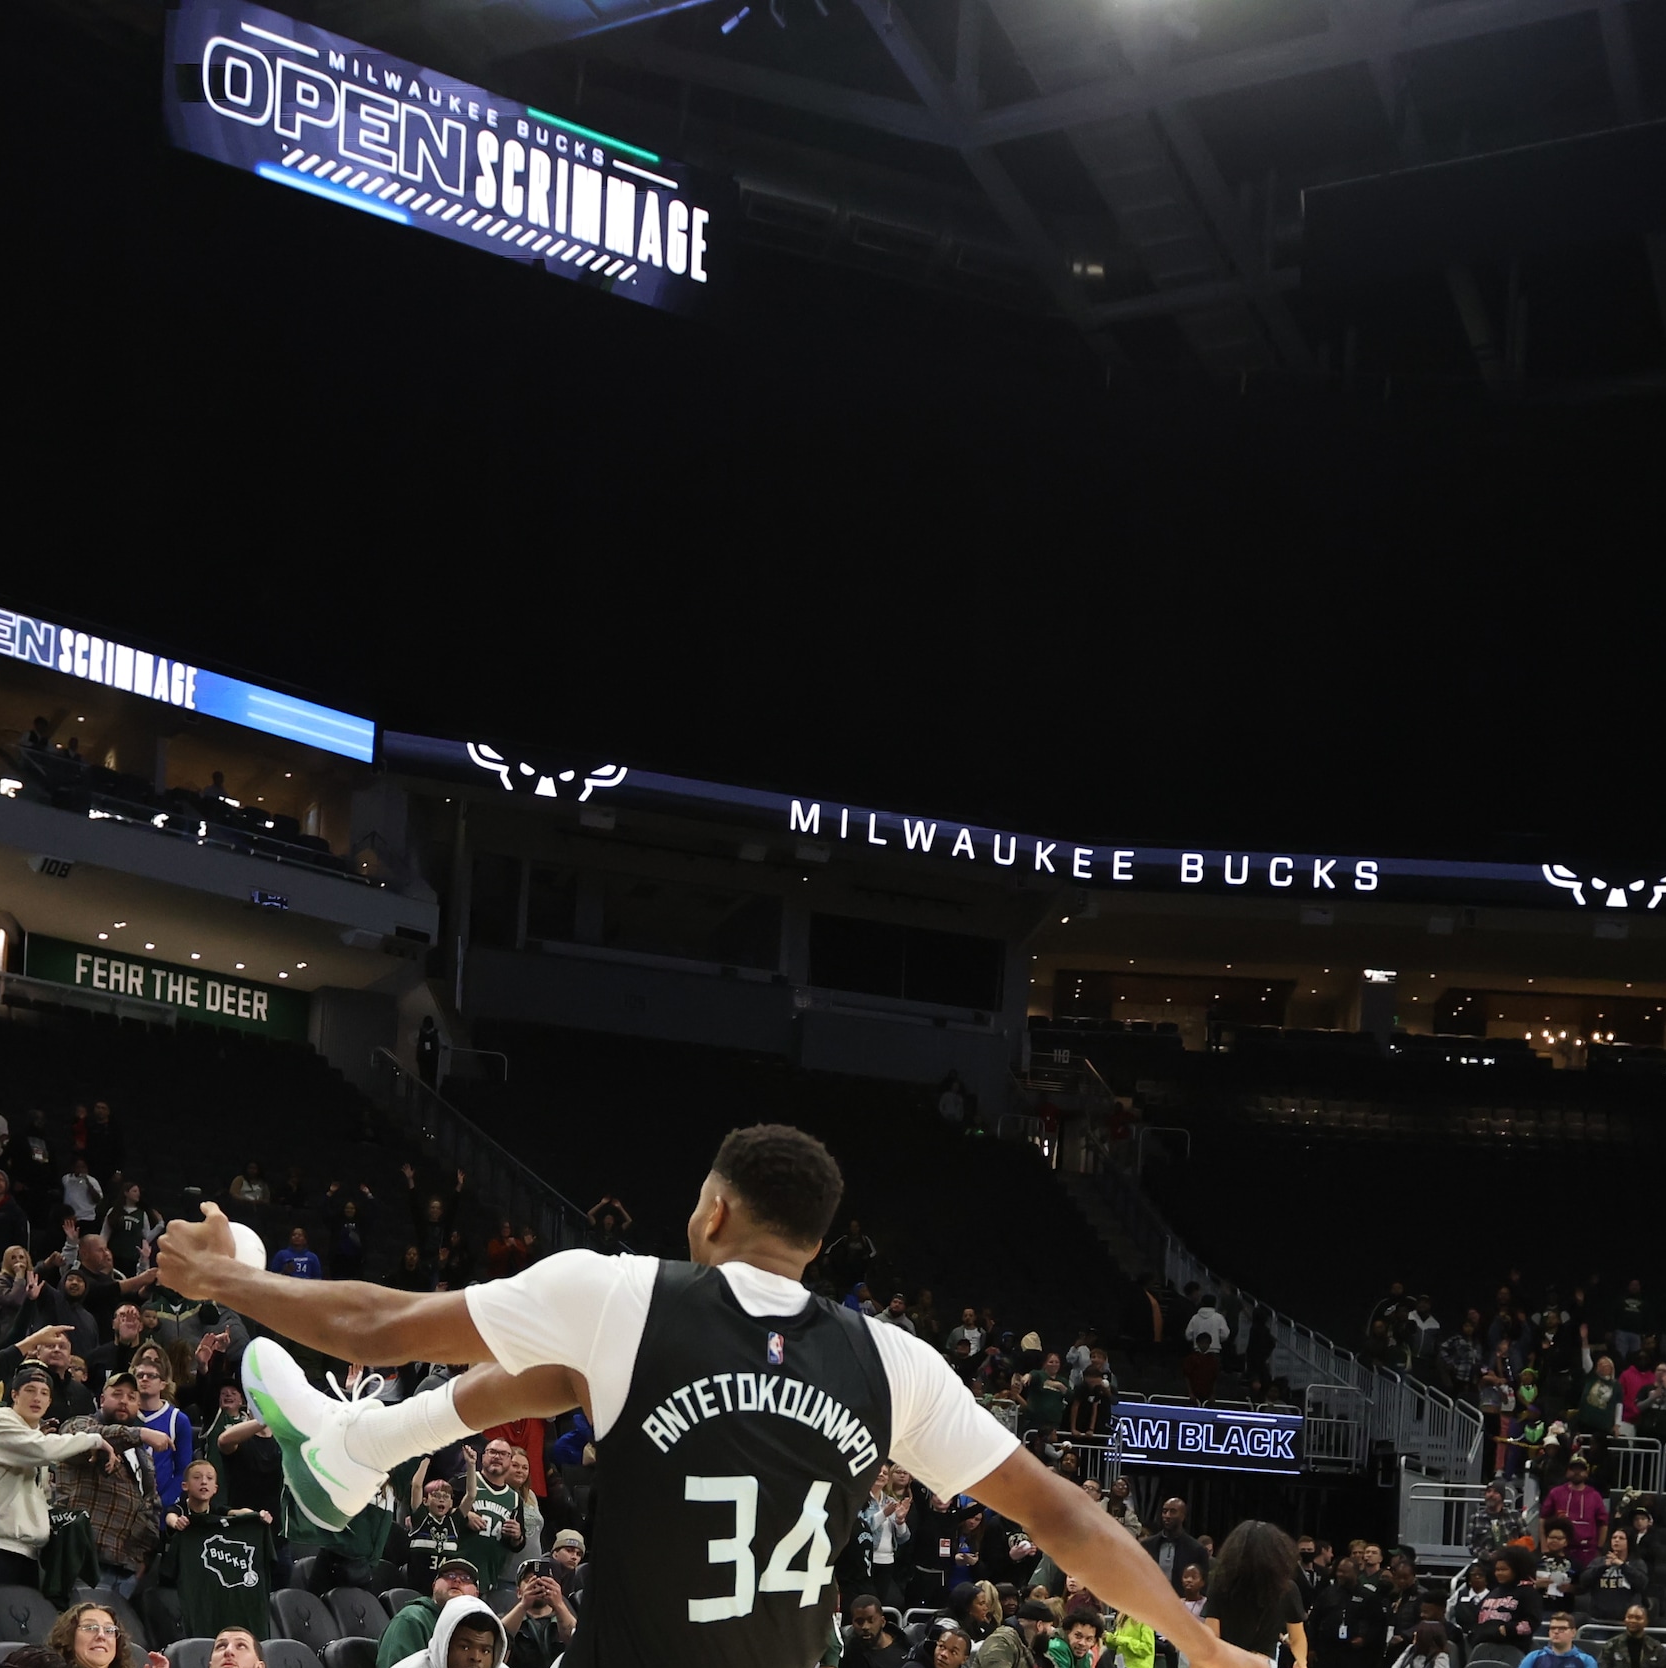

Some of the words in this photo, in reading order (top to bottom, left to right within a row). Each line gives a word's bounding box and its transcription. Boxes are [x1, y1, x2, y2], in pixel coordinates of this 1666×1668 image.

[328, 50, 500, 129] MILWAUKEE
[516, 118, 606, 167] BUCKS
[202, 35, 469, 198] OPEN
[474, 129, 710, 284] SCRIMMAGE
[58, 627, 198, 711] SCRIMMAGE
[41, 857, 72, 878] 108
[789, 800, 1135, 882] MILWAUKEE
[1180, 852, 1379, 892] BUCKS
[74, 952, 145, 997] FEAR
[150, 968, 200, 1008] THE
[205, 980, 269, 1022] DEER
[641, 1372, 879, 1478] ANTETOKOUNMPO
[1177, 1421, 1296, 1460] BLACK
[472, 1499, 513, 1521] MILWAUKE
[479, 1514, 503, 1542] 34
[210, 1547, 247, 1570] BUCKS
[684, 1474, 835, 1624] 34
